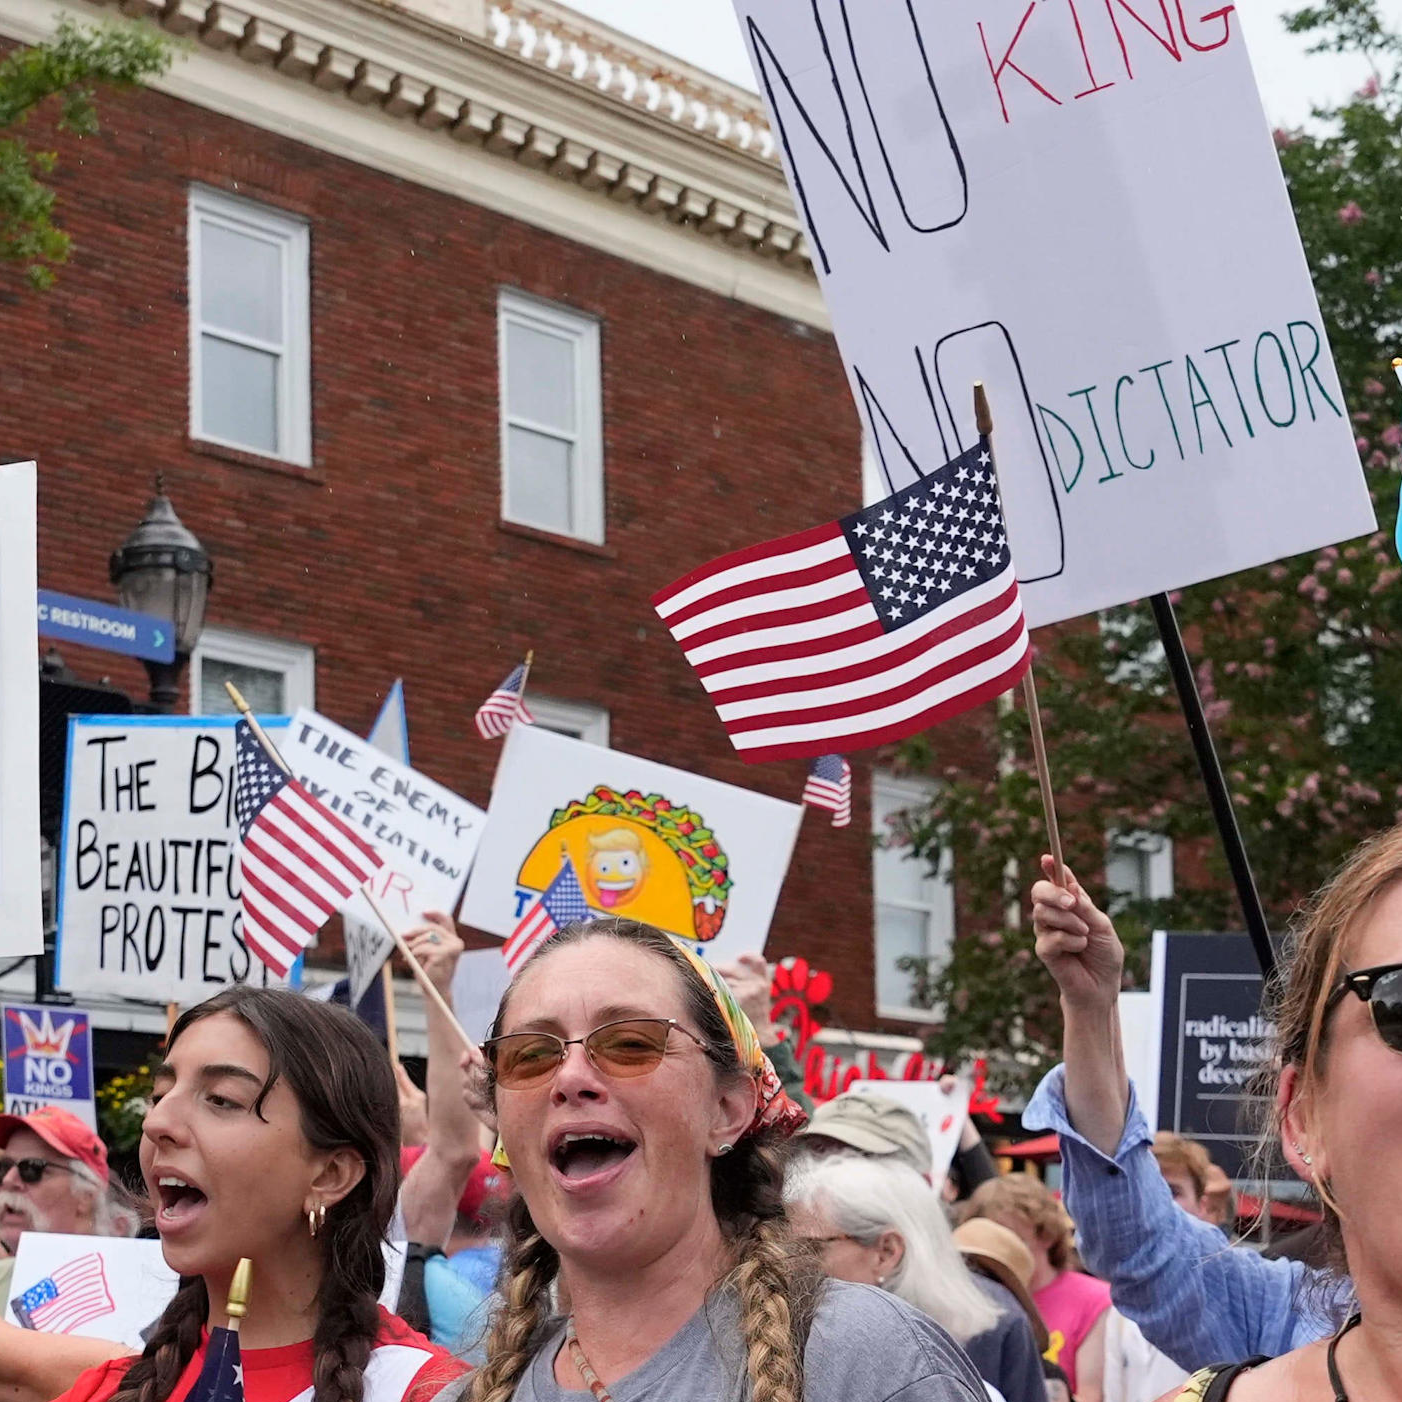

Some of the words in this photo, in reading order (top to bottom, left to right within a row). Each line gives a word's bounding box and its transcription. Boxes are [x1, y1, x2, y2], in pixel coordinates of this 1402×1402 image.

[747, 0, 967, 275] NO
[977, 0, 1236, 123] KING
[1035, 321, 1343, 494] DICTATOR
[50, 607, 136, 641] RESTROOM
[87, 735, 157, 812] THE
[190, 734, 240, 829] BI
[297, 719, 364, 772] THE
[370, 765, 473, 838] ENEMY
[76, 819, 243, 900] BEAUTIFU
[298, 774, 460, 880] IVILIZATION
[24, 1056, 73, 1085] NO
[24, 1083, 74, 1098] KINGS
[1200, 1039, 1227, 1066] by
